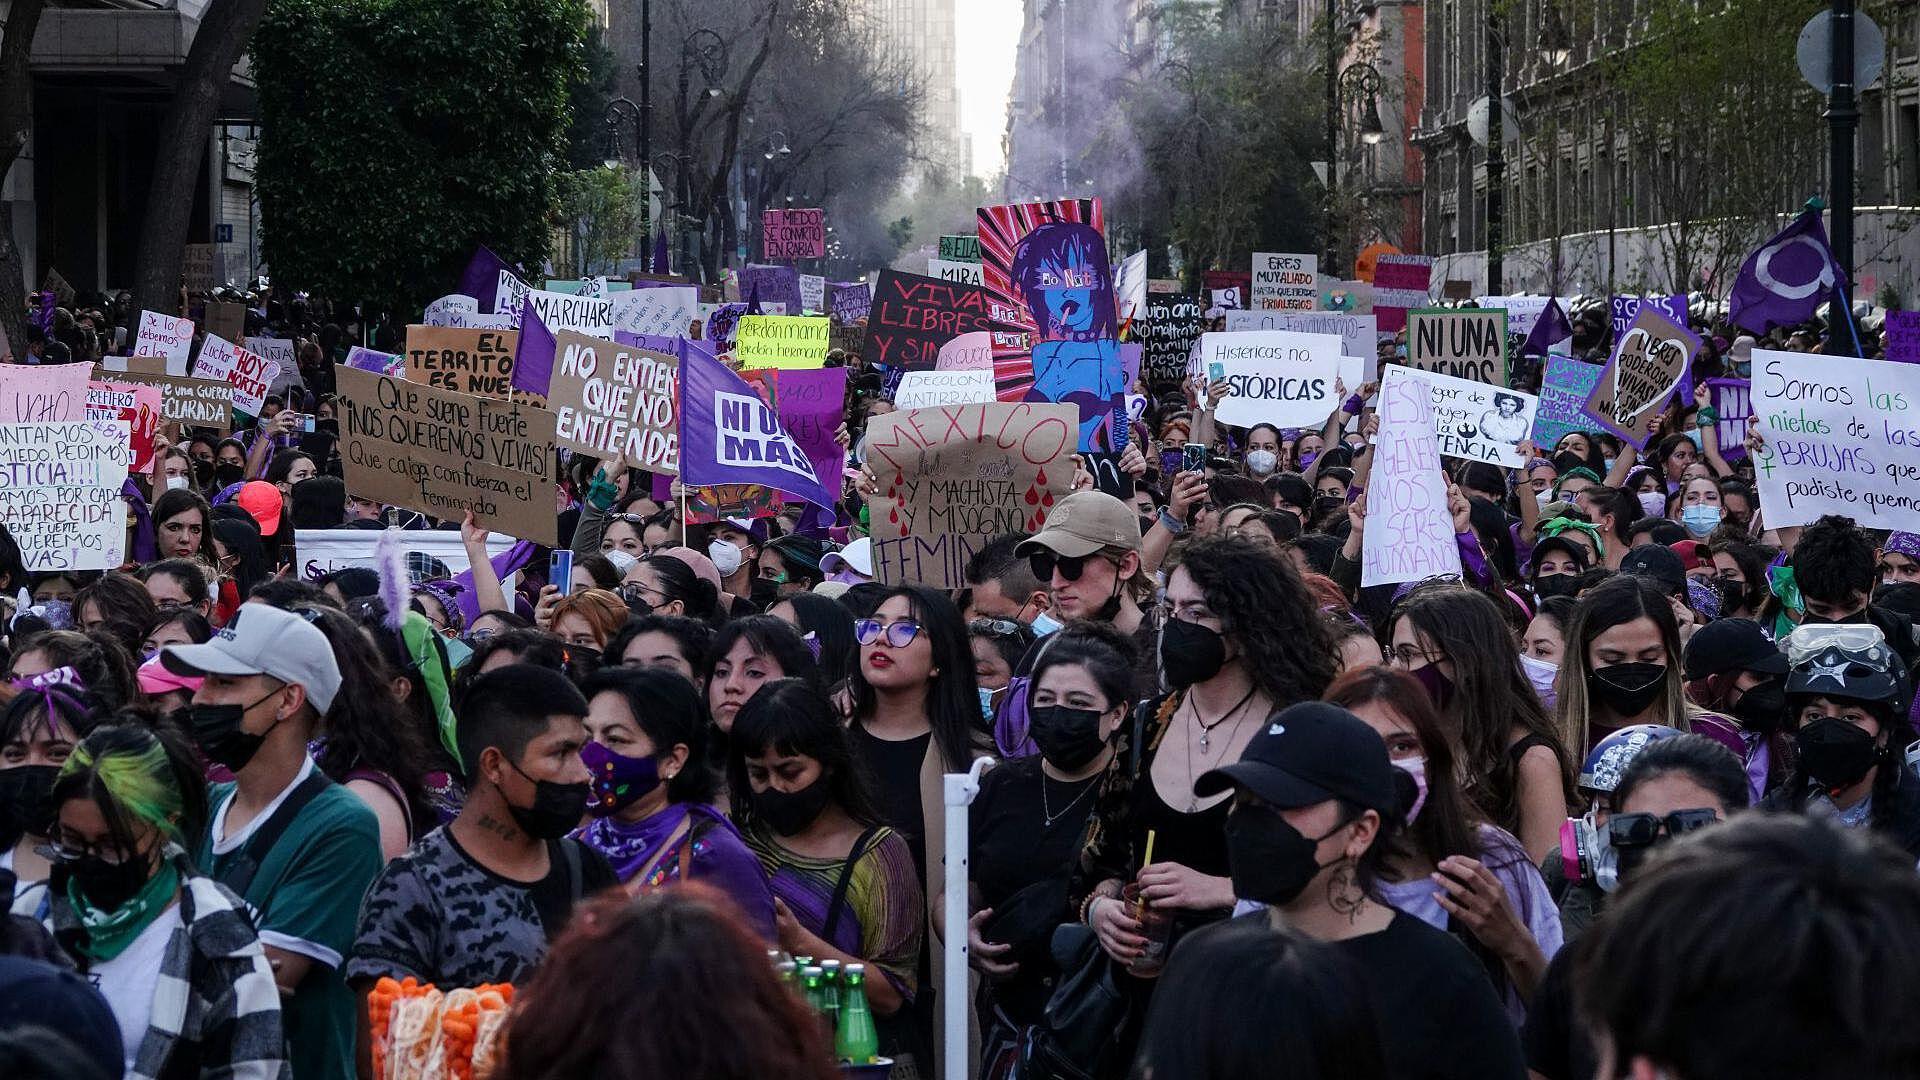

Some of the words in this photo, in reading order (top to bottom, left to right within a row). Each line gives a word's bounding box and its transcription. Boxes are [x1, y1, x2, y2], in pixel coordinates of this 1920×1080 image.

[765, 227, 778, 241] SE
[769, 242, 783, 257] EN
[786, 242, 815, 257] RABIA
[1268, 257, 1302, 270] ERES
[941, 267, 981, 287] MIRA
[146, 314, 158, 326] Se
[164, 316, 175, 330] lo
[1171, 302, 1203, 320] ama
[138, 327, 180, 348] debemos
[477, 333, 509, 353] EL
[872, 334, 893, 362] Y
[1417, 316, 1443, 359] NI
[1450, 316, 1500, 358] UNA
[1636, 332, 1681, 367] LIBRES
[235, 350, 268, 381] HOY
[561, 342, 598, 380] NO
[1150, 352, 1187, 368] pega
[1214, 344, 1282, 361] Histéricas
[1288, 347, 1314, 362] no.
[428, 371, 460, 392] ES
[1416, 359, 1494, 385] NOS
[1618, 353, 1674, 392] PODEROSAS
[1764, 360, 1853, 406] Somos
[1866, 376, 1909, 412] las
[377, 375, 420, 415] Que
[425, 395, 471, 429] suene
[582, 376, 633, 419] QUE
[631, 389, 675, 429] NO
[1468, 390, 1488, 406] de
[1621, 395, 1641, 413] SIN
[1719, 386, 1749, 419] NI
[721, 398, 751, 433] NI
[1435, 418, 1454, 435] la
[1768, 407, 1832, 435] nietas
[1846, 415, 1871, 440] de
[1884, 419, 1920, 448] las
[388, 414, 485, 461] QUEREMOS
[556, 405, 680, 470] ENTIENDE
[872, 404, 1068, 471] MÉXICO
[55, 440, 128, 467] PEDIMOS
[723, 434, 813, 476] MÁS
[1776, 440, 1876, 475] BRUJAS
[1885, 463, 1920, 486] que
[349, 439, 382, 469] Que
[387, 455, 430, 484] caiga
[514, 480, 533, 502] el
[57, 487, 84, 504] POR
[89, 487, 123, 504] CADA
[905, 480, 920, 504] Y
[928, 479, 1022, 507] MACHISTA
[1786, 477, 1858, 509] pudiste
[36, 521, 80, 535] FUERTE
[903, 506, 917, 535] Y
[12, 533, 102, 551] UEREMOS
